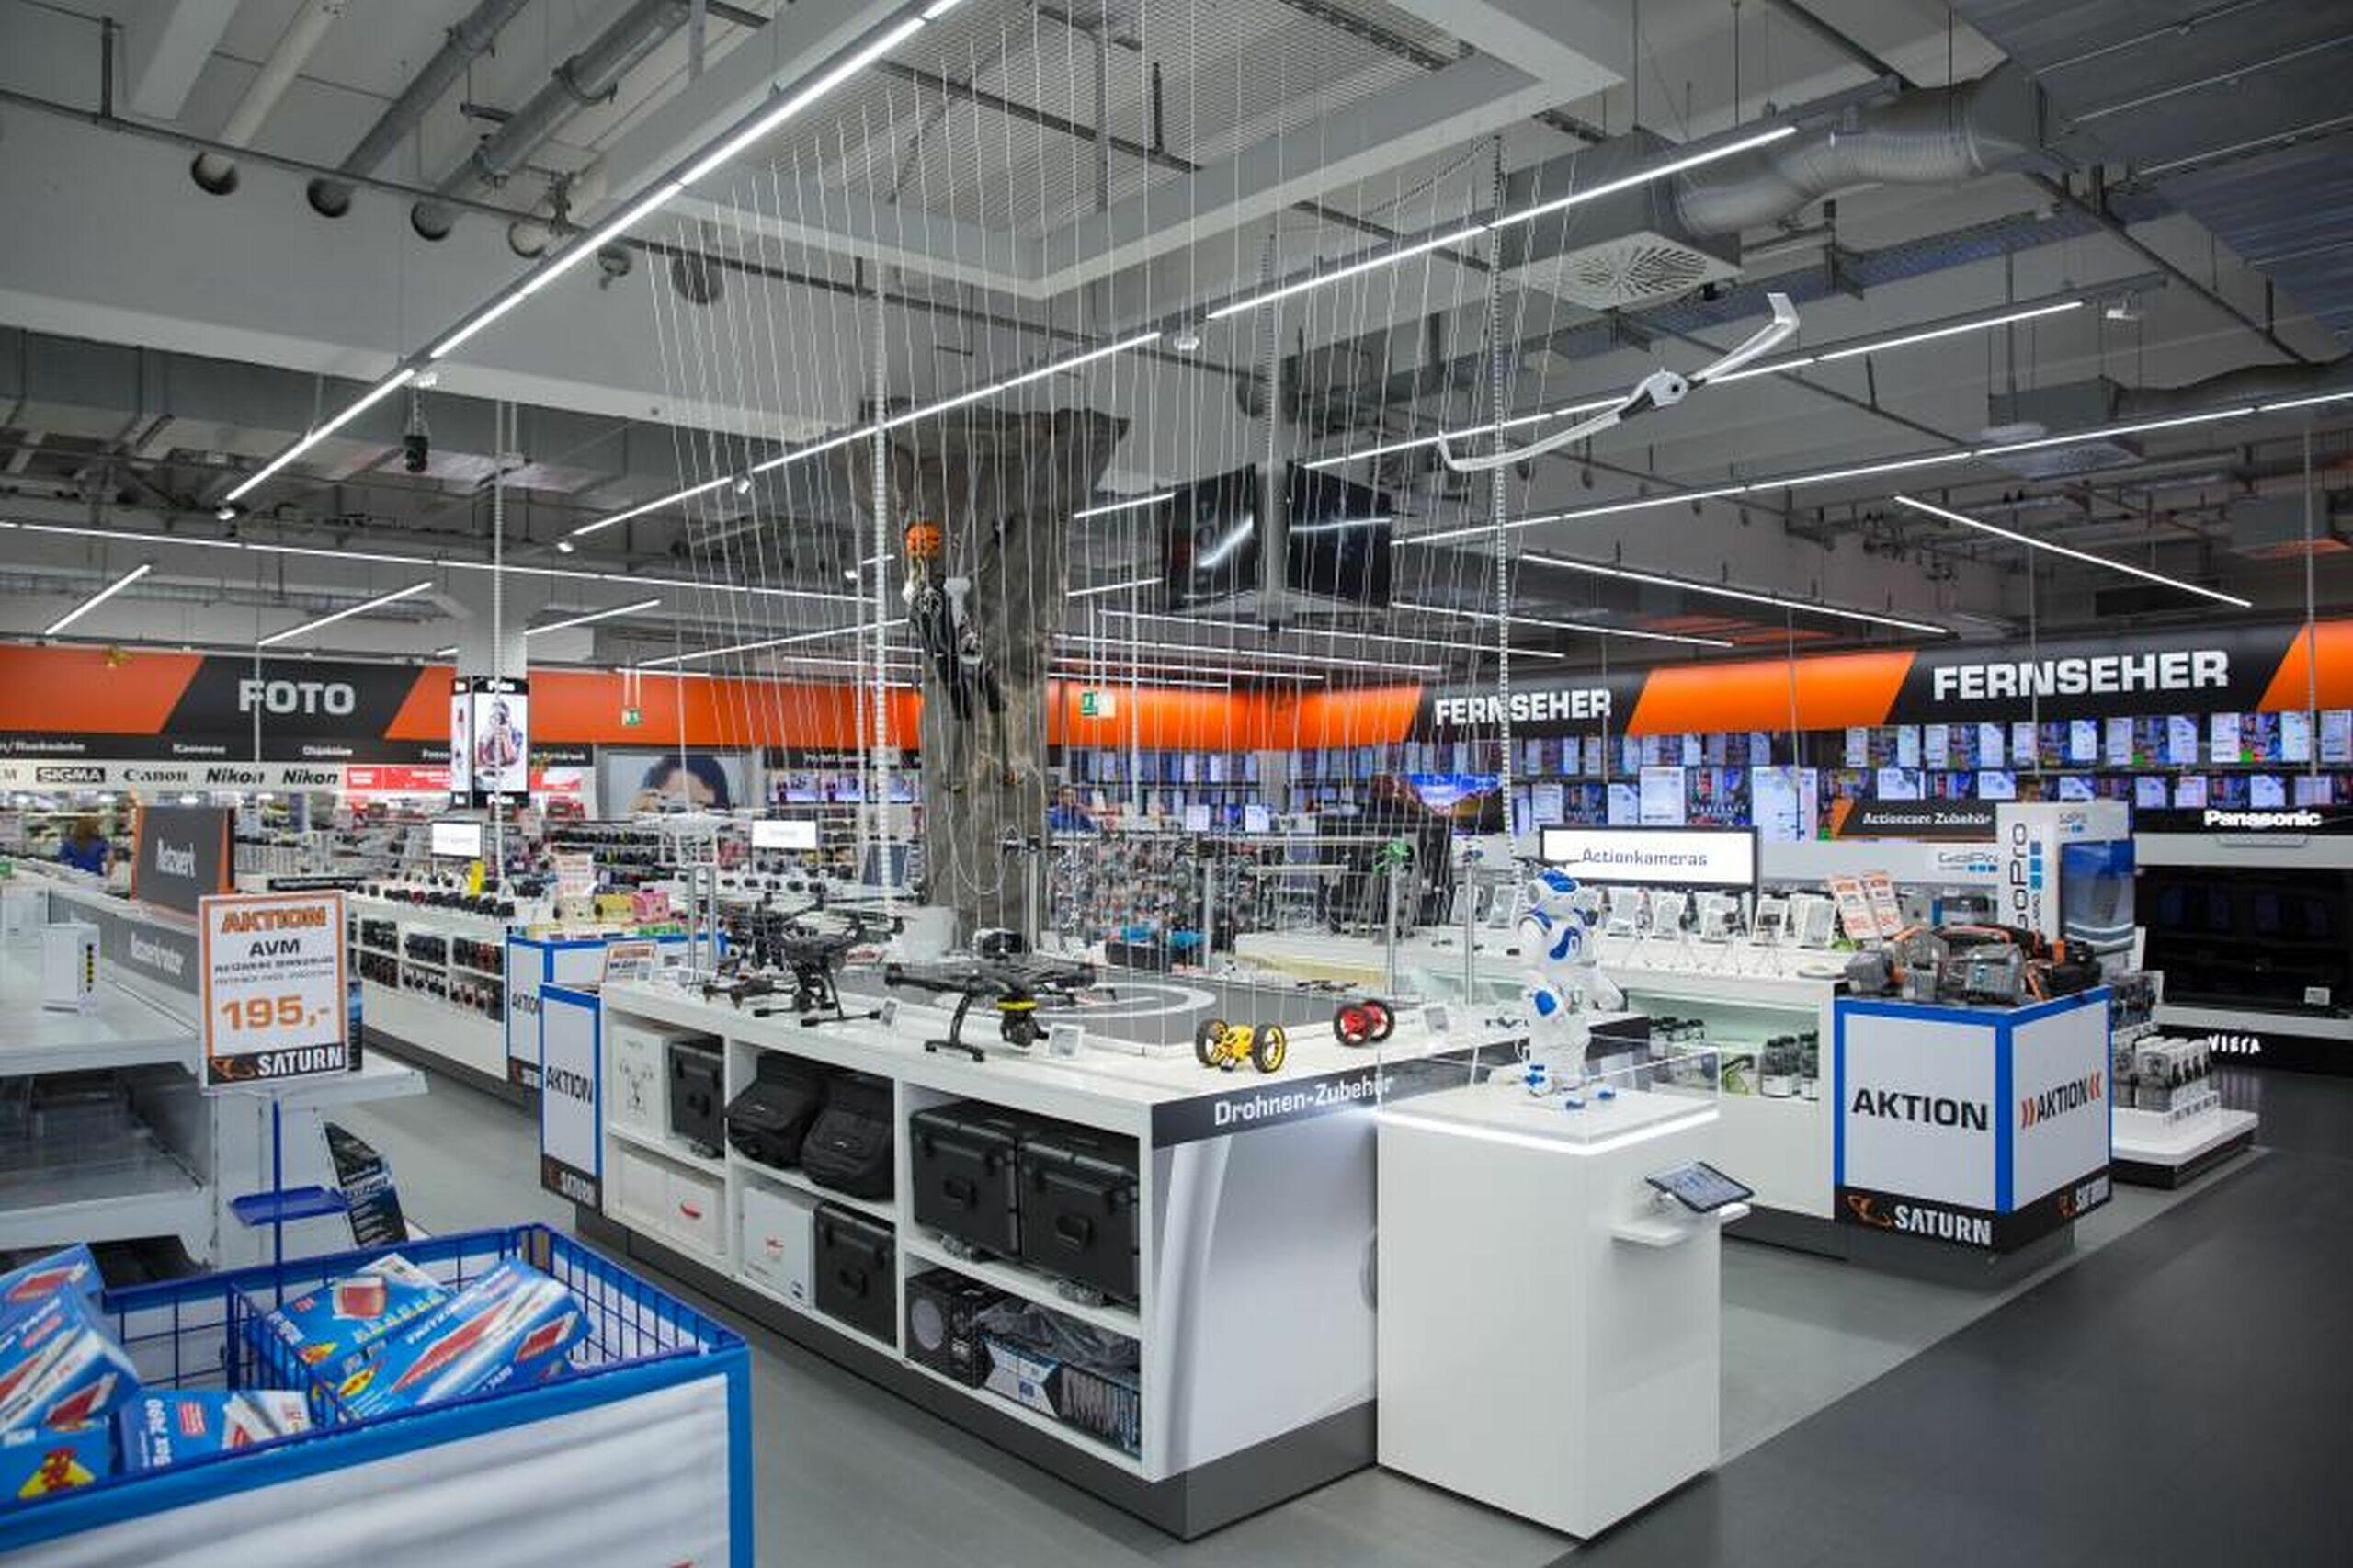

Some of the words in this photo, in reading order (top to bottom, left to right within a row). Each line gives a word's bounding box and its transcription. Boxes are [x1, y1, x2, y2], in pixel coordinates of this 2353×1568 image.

[1933, 651, 2229, 701] FERNSEHER
[239, 680, 356, 716] FOTO
[1435, 689, 1611, 726] FERNSEHER
[38, 767, 105, 781] SIGMA
[123, 768, 188, 782] Canon
[205, 769, 265, 784] Nikon
[282, 770, 339, 785] Nikon
[1934, 812, 1992, 825] Zubehör
[2204, 810, 2322, 827] Panasonic
[1582, 847, 1709, 867] Actionkameras
[221, 906, 326, 934] AKTION
[248, 938, 301, 957] AVM
[220, 995, 331, 1031] 195,-
[257, 1044, 344, 1076] SATURN
[546, 1065, 594, 1104] AKTION
[1851, 1088, 1988, 1131] AKTION
[2035, 1077, 2088, 1123] AKTION
[1893, 1204, 1992, 1246] SATURN
